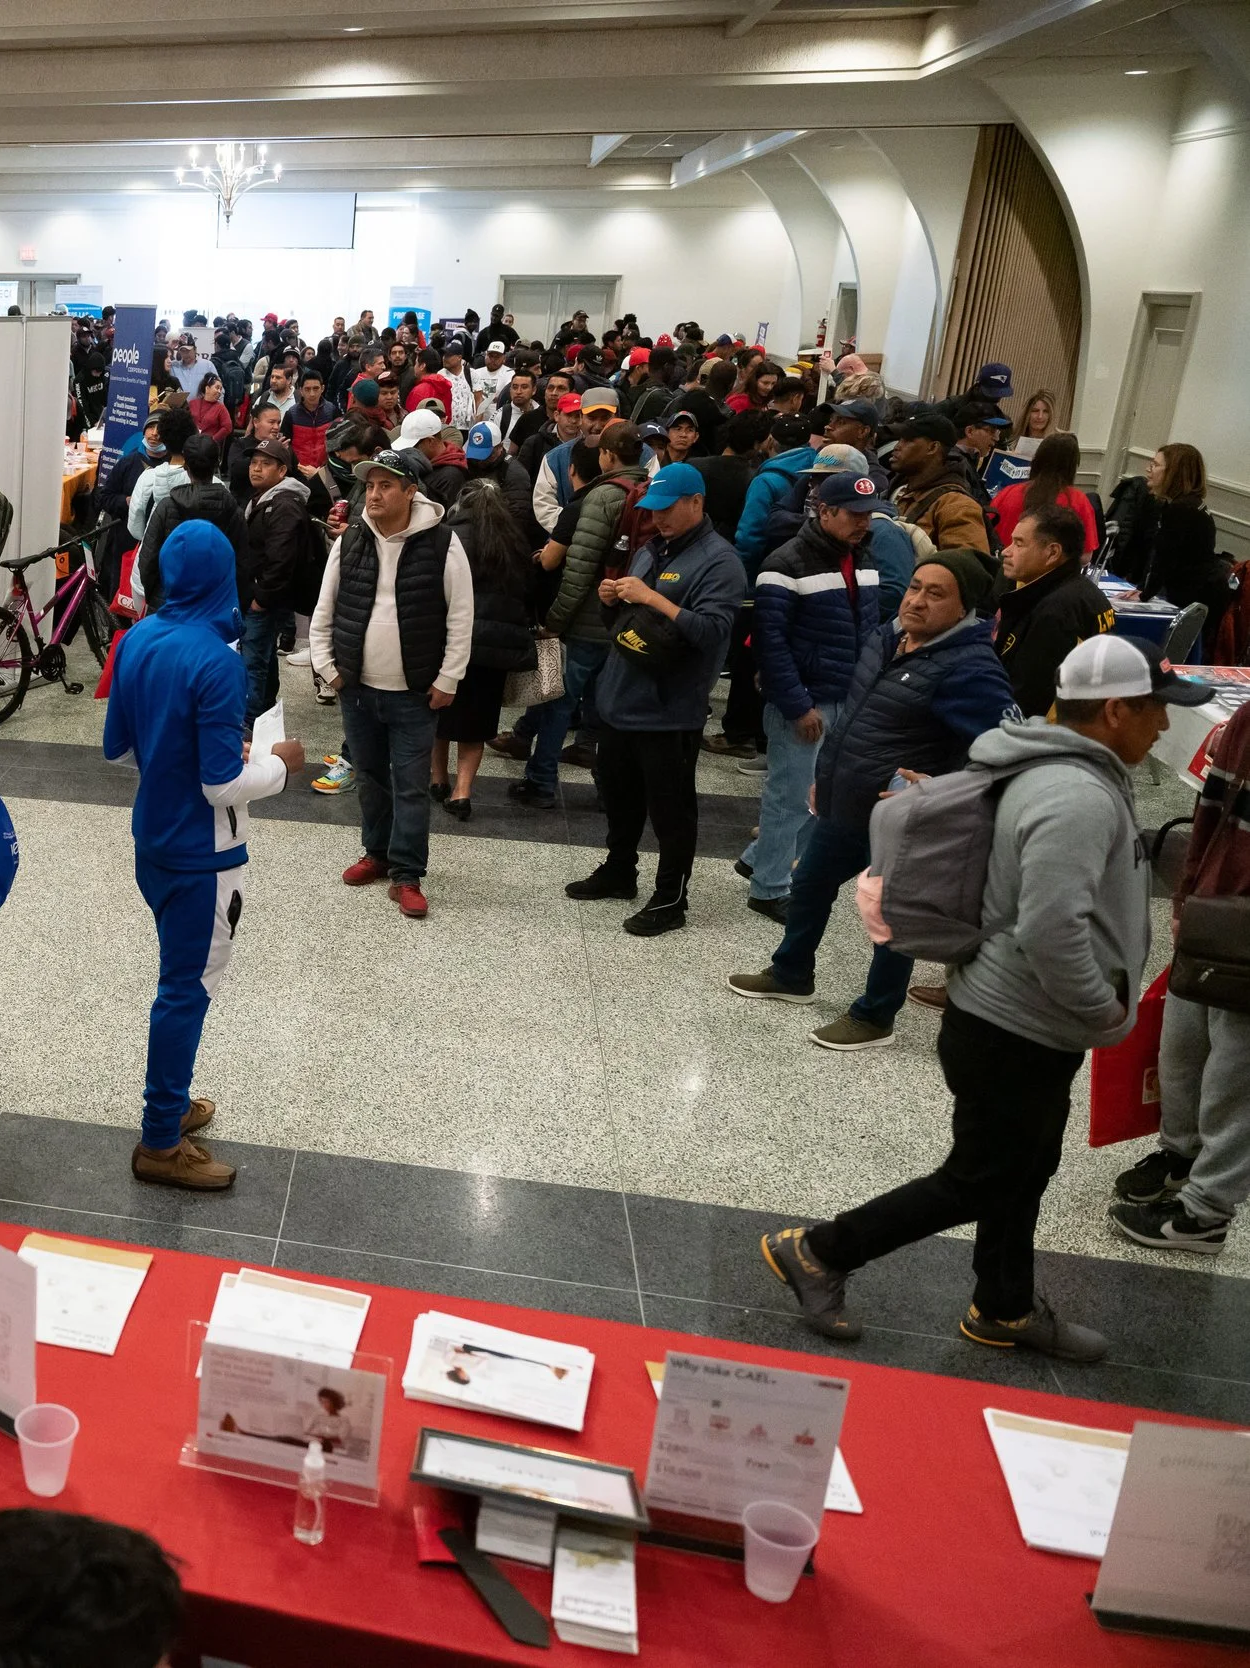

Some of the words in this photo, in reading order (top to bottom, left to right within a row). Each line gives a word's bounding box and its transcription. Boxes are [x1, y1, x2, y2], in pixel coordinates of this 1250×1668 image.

[112, 343, 139, 367] people
[622, 628, 649, 648] NIKE
[670, 1357, 699, 1374] Why
